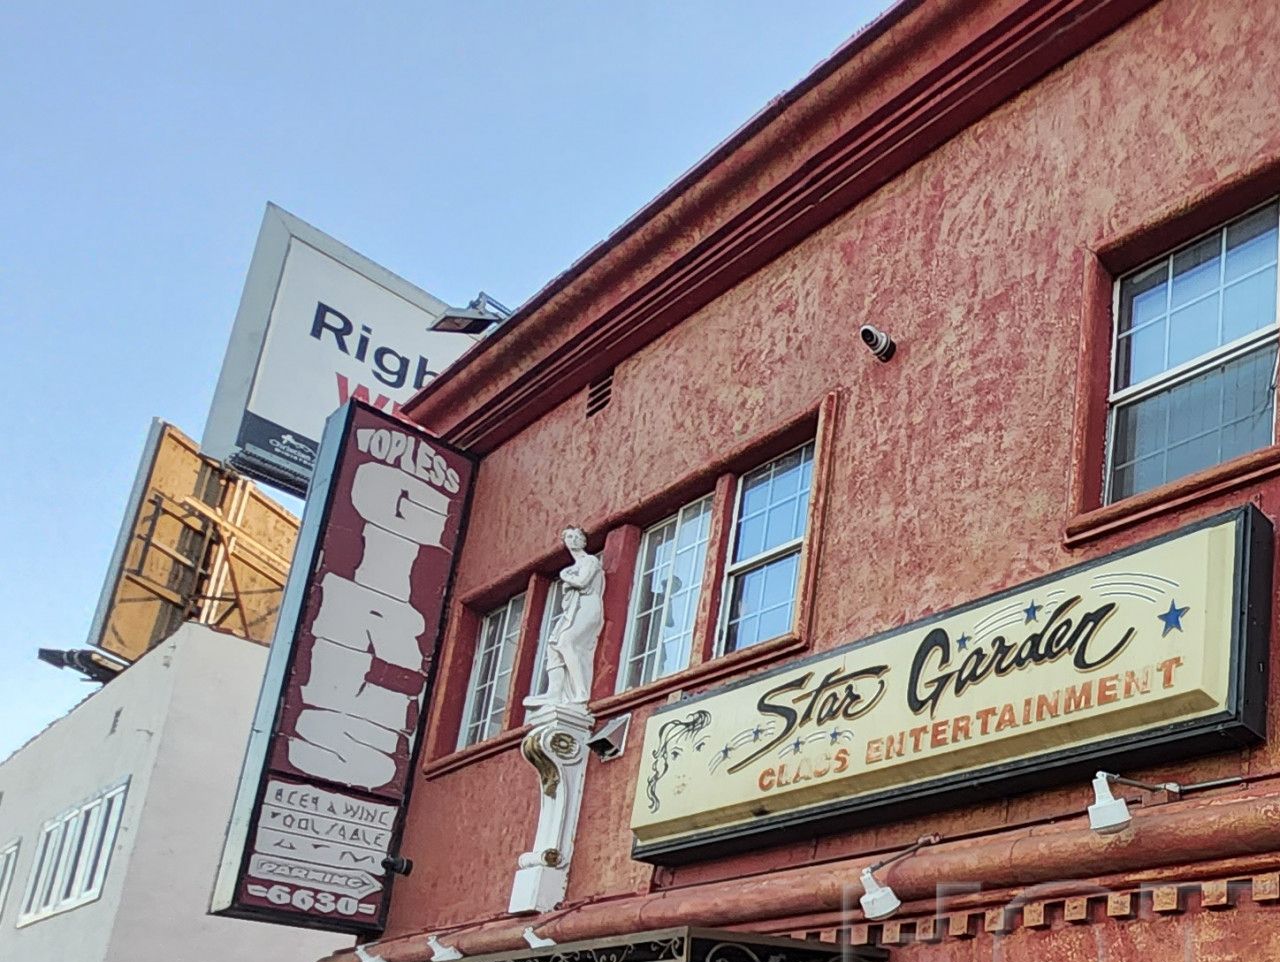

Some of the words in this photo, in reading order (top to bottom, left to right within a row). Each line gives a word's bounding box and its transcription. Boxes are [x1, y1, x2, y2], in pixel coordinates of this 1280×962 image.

[355, 428, 460, 494] TOPLESS
[287, 461, 452, 792] GIRLS
[727, 663, 890, 775] Star
[906, 595, 1136, 717] Garden
[865, 655, 1186, 765] ENTERTAINMENT
